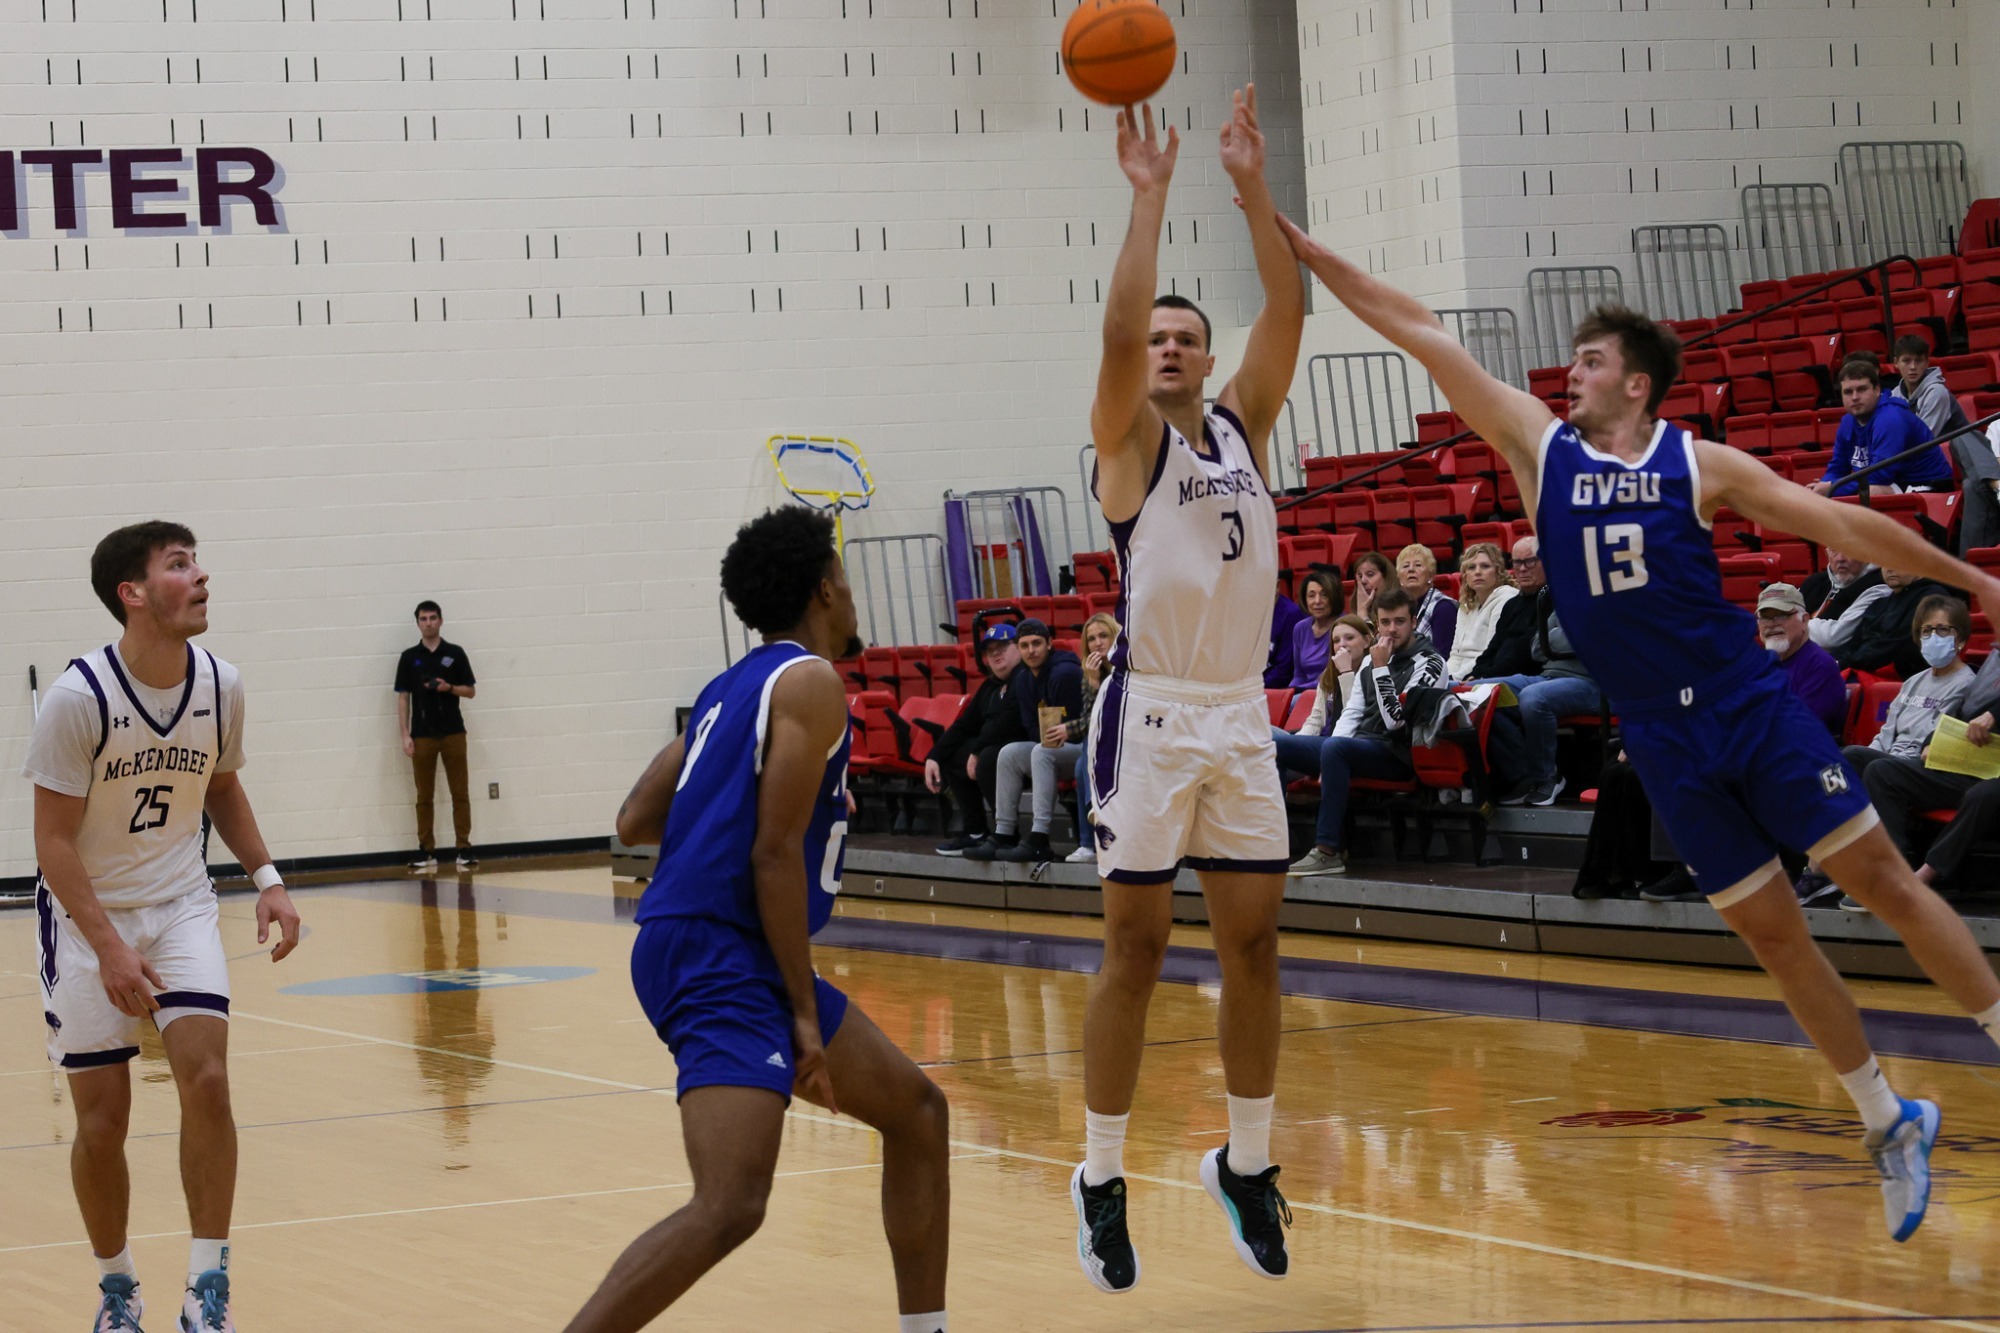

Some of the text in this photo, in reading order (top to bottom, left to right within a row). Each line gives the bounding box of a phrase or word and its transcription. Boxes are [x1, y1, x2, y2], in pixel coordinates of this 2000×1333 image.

[1571, 471, 1662, 506] GVSU
[1221, 510, 1245, 562] 3
[1583, 523, 1649, 597] 13
[103, 746, 208, 782] McKENDREE
[129, 784, 174, 834] 25
[1500, 928, 1507, 943] A
